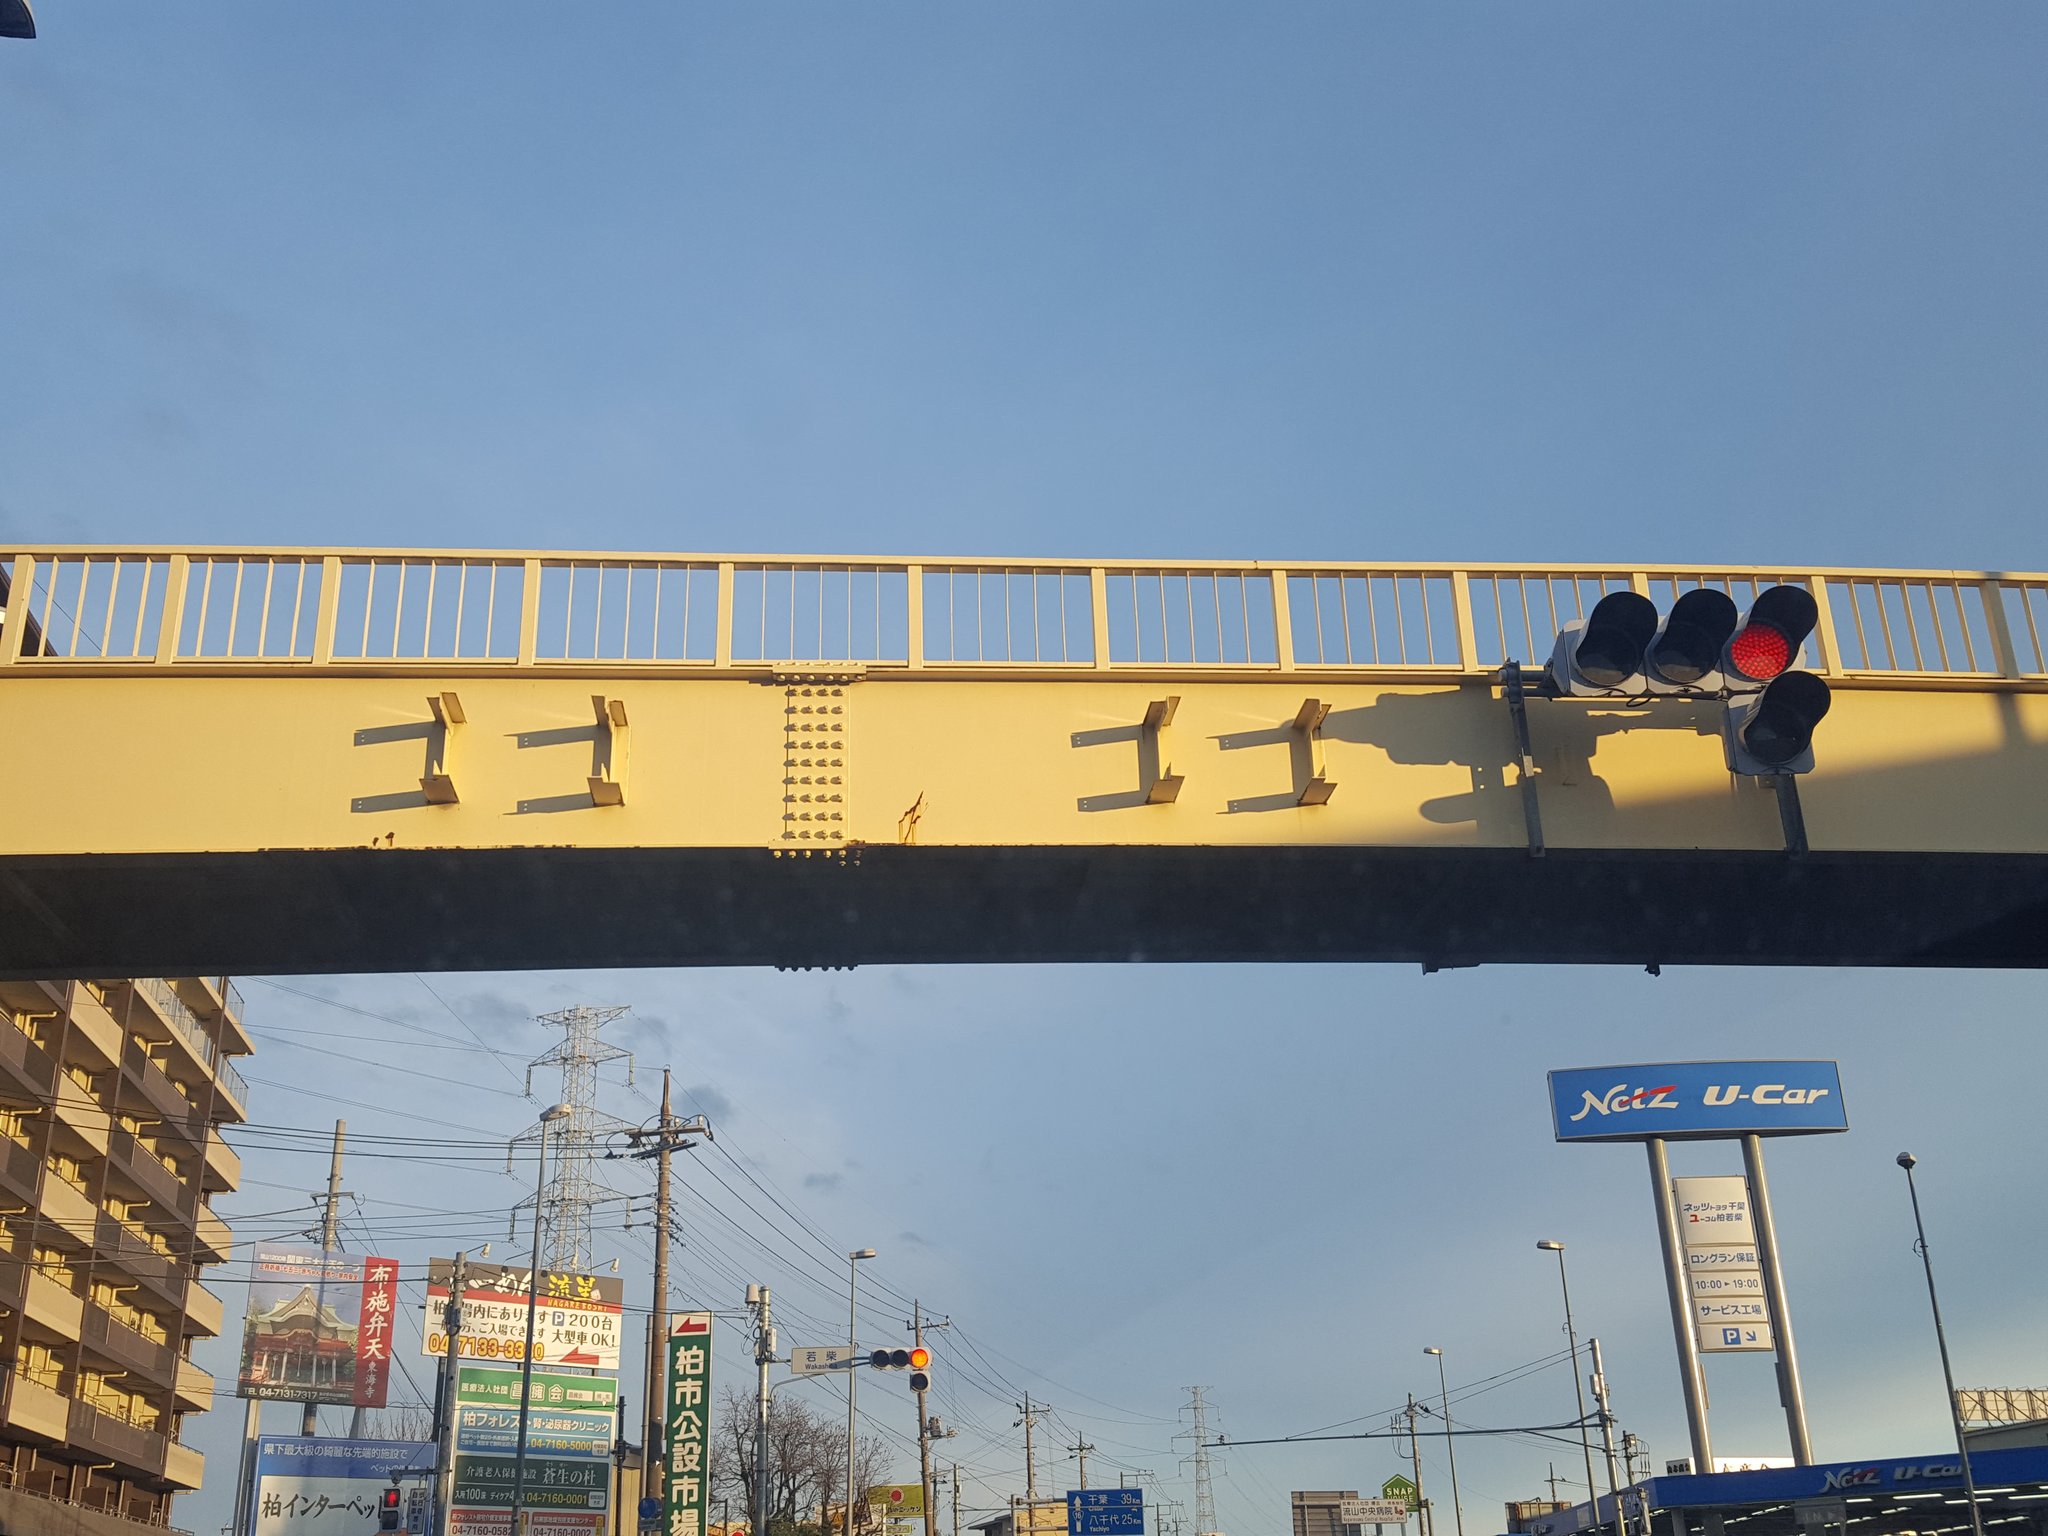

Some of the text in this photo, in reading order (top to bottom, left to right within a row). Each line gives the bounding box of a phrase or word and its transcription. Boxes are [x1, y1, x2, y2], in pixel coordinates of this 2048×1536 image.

[1570, 1083, 1829, 1122] Netz U-Car
[1683, 1201, 1745, 1212] ネッツトヨタ千葉
[1690, 1252, 1755, 1264] ロングラン保証
[548, 1274, 597, 1301] 流星
[1695, 1278, 1759, 1290] 10:00 19:00
[363, 1264, 392, 1360] 布施弁天
[1700, 1304, 1762, 1316] サービス工場
[569, 1314, 613, 1331] 200台
[552, 1329, 588, 1345] 大型車
[428, 1333, 545, 1361] 047133-330
[806, 1350, 837, 1362] 若柴
[365, 1360, 378, 1399] 東海寺
[244, 1388, 258, 1396] TEL
[259, 1387, 317, 1400] 04-7131-7317
[461, 1382, 508, 1395] 医療法人社団
[531, 1439, 592, 1451] 04-7160-5000
[670, 1345, 705, 1536] 柏市公設市場
[542, 1468, 596, 1486] 蒼生の杜
[1386, 1487, 1413, 1496] SNAP
[527, 1492, 587, 1504] 04-7160-0001
[1088, 1494, 1108, 1505] 千葉
[1343, 1506, 1393, 1516] 流山中央病院
[1089, 1514, 1119, 1525] 八千代
